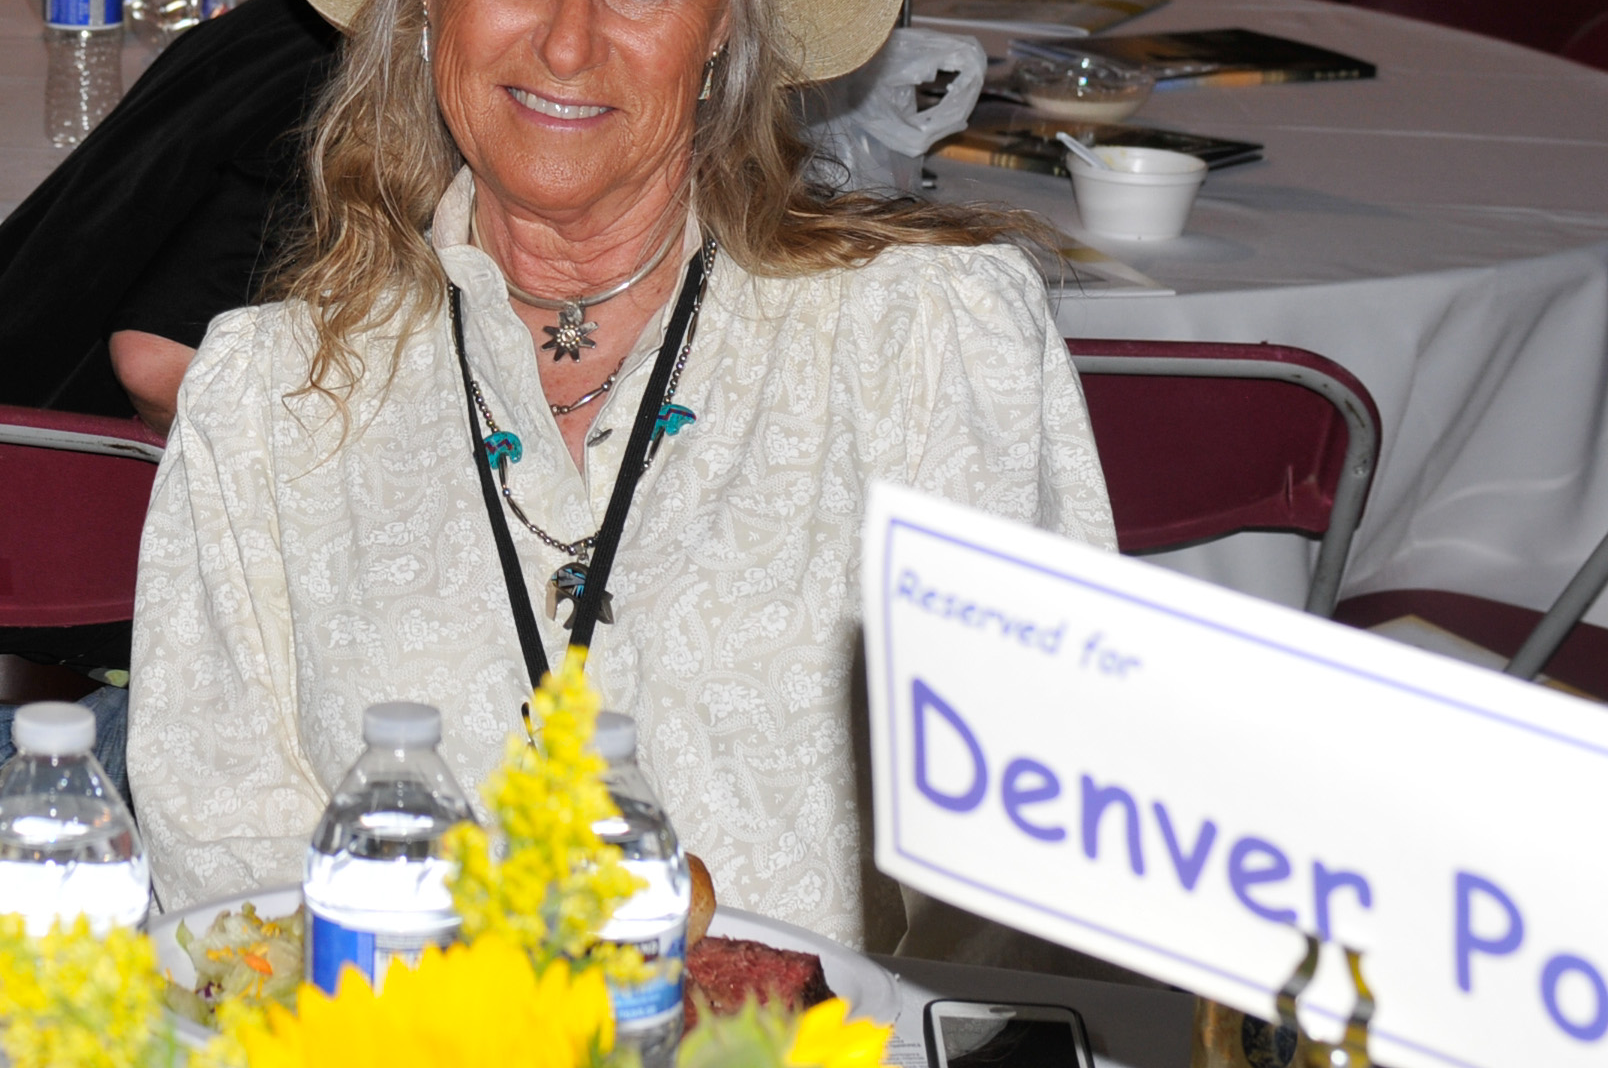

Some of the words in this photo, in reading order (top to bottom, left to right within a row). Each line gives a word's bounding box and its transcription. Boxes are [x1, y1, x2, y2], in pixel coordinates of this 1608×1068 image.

[898, 570, 1065, 655] Reserved
[1082, 631, 1144, 680] for
[911, 676, 1374, 943] Denver
[1454, 869, 1608, 1043] Po
